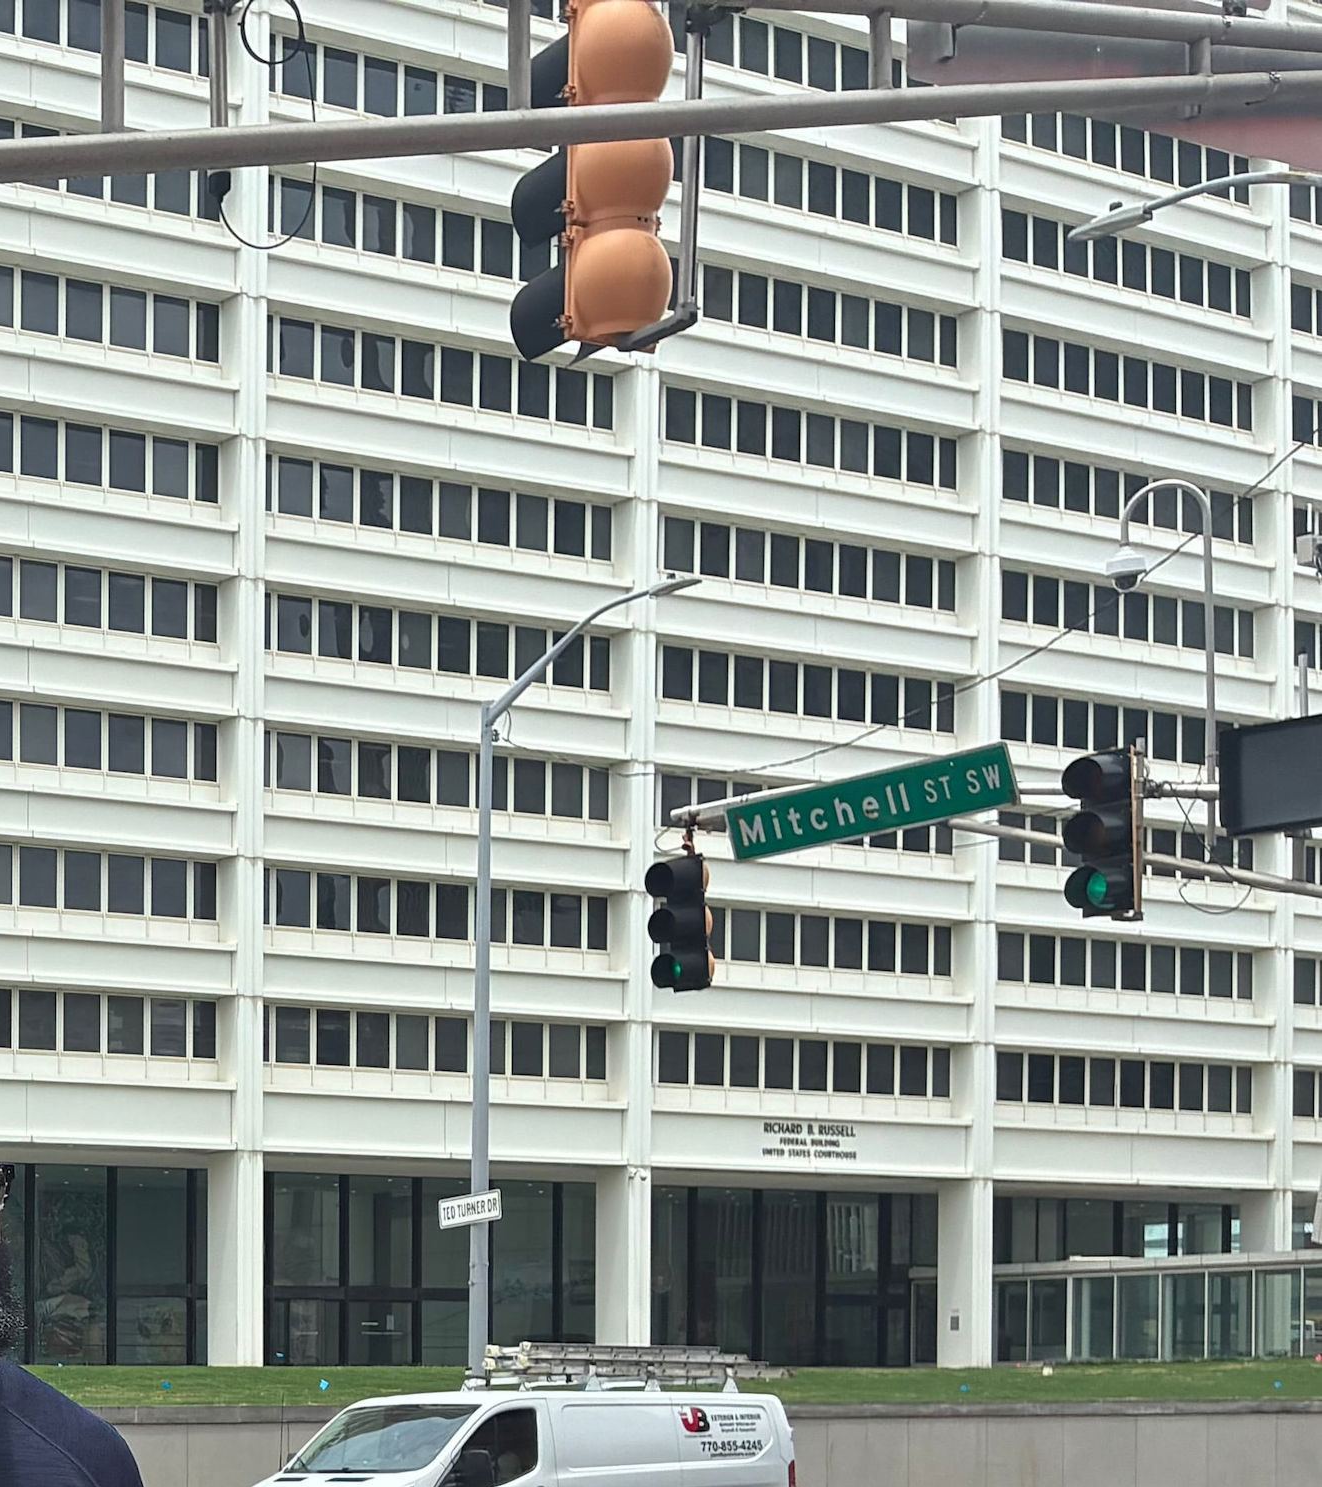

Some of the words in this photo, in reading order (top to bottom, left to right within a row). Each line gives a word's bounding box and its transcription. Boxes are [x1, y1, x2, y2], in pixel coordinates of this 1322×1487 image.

[738, 783, 911, 848] Mitchell
[923, 775, 952, 804] ST
[965, 763, 1001, 796] SW
[763, 1122, 803, 1134] RICHARD
[818, 1124, 856, 1138] RUSSELL
[443, 1206, 456, 1221] TED
[457, 1200, 486, 1218] TURNER
[487, 1197, 498, 1213] DR
